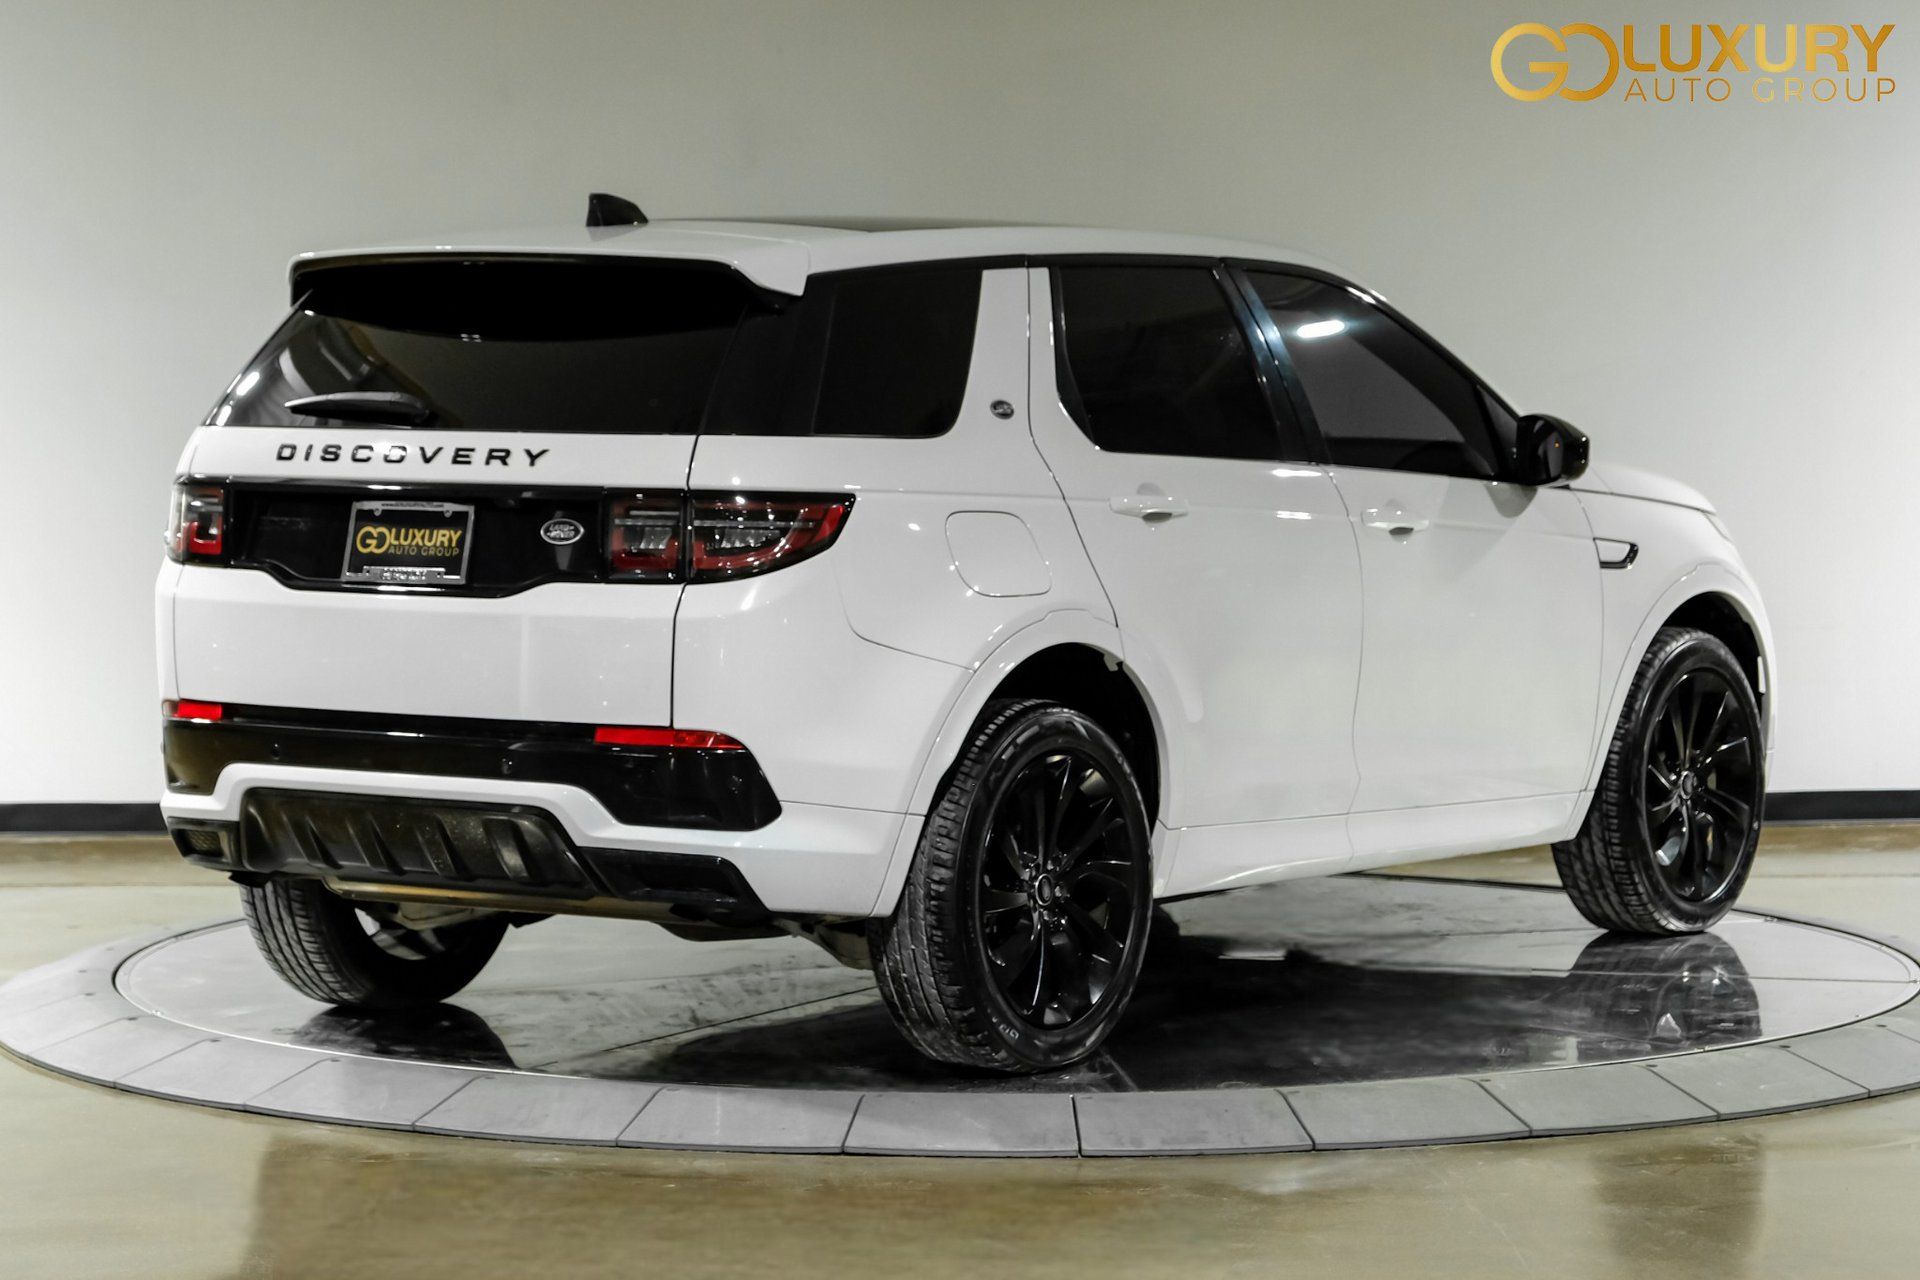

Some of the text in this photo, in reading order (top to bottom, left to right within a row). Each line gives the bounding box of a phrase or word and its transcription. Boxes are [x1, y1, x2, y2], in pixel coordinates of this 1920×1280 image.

[276, 443, 550, 467] DISCOVERY
[388, 545, 460, 556] AUTO GROUP
